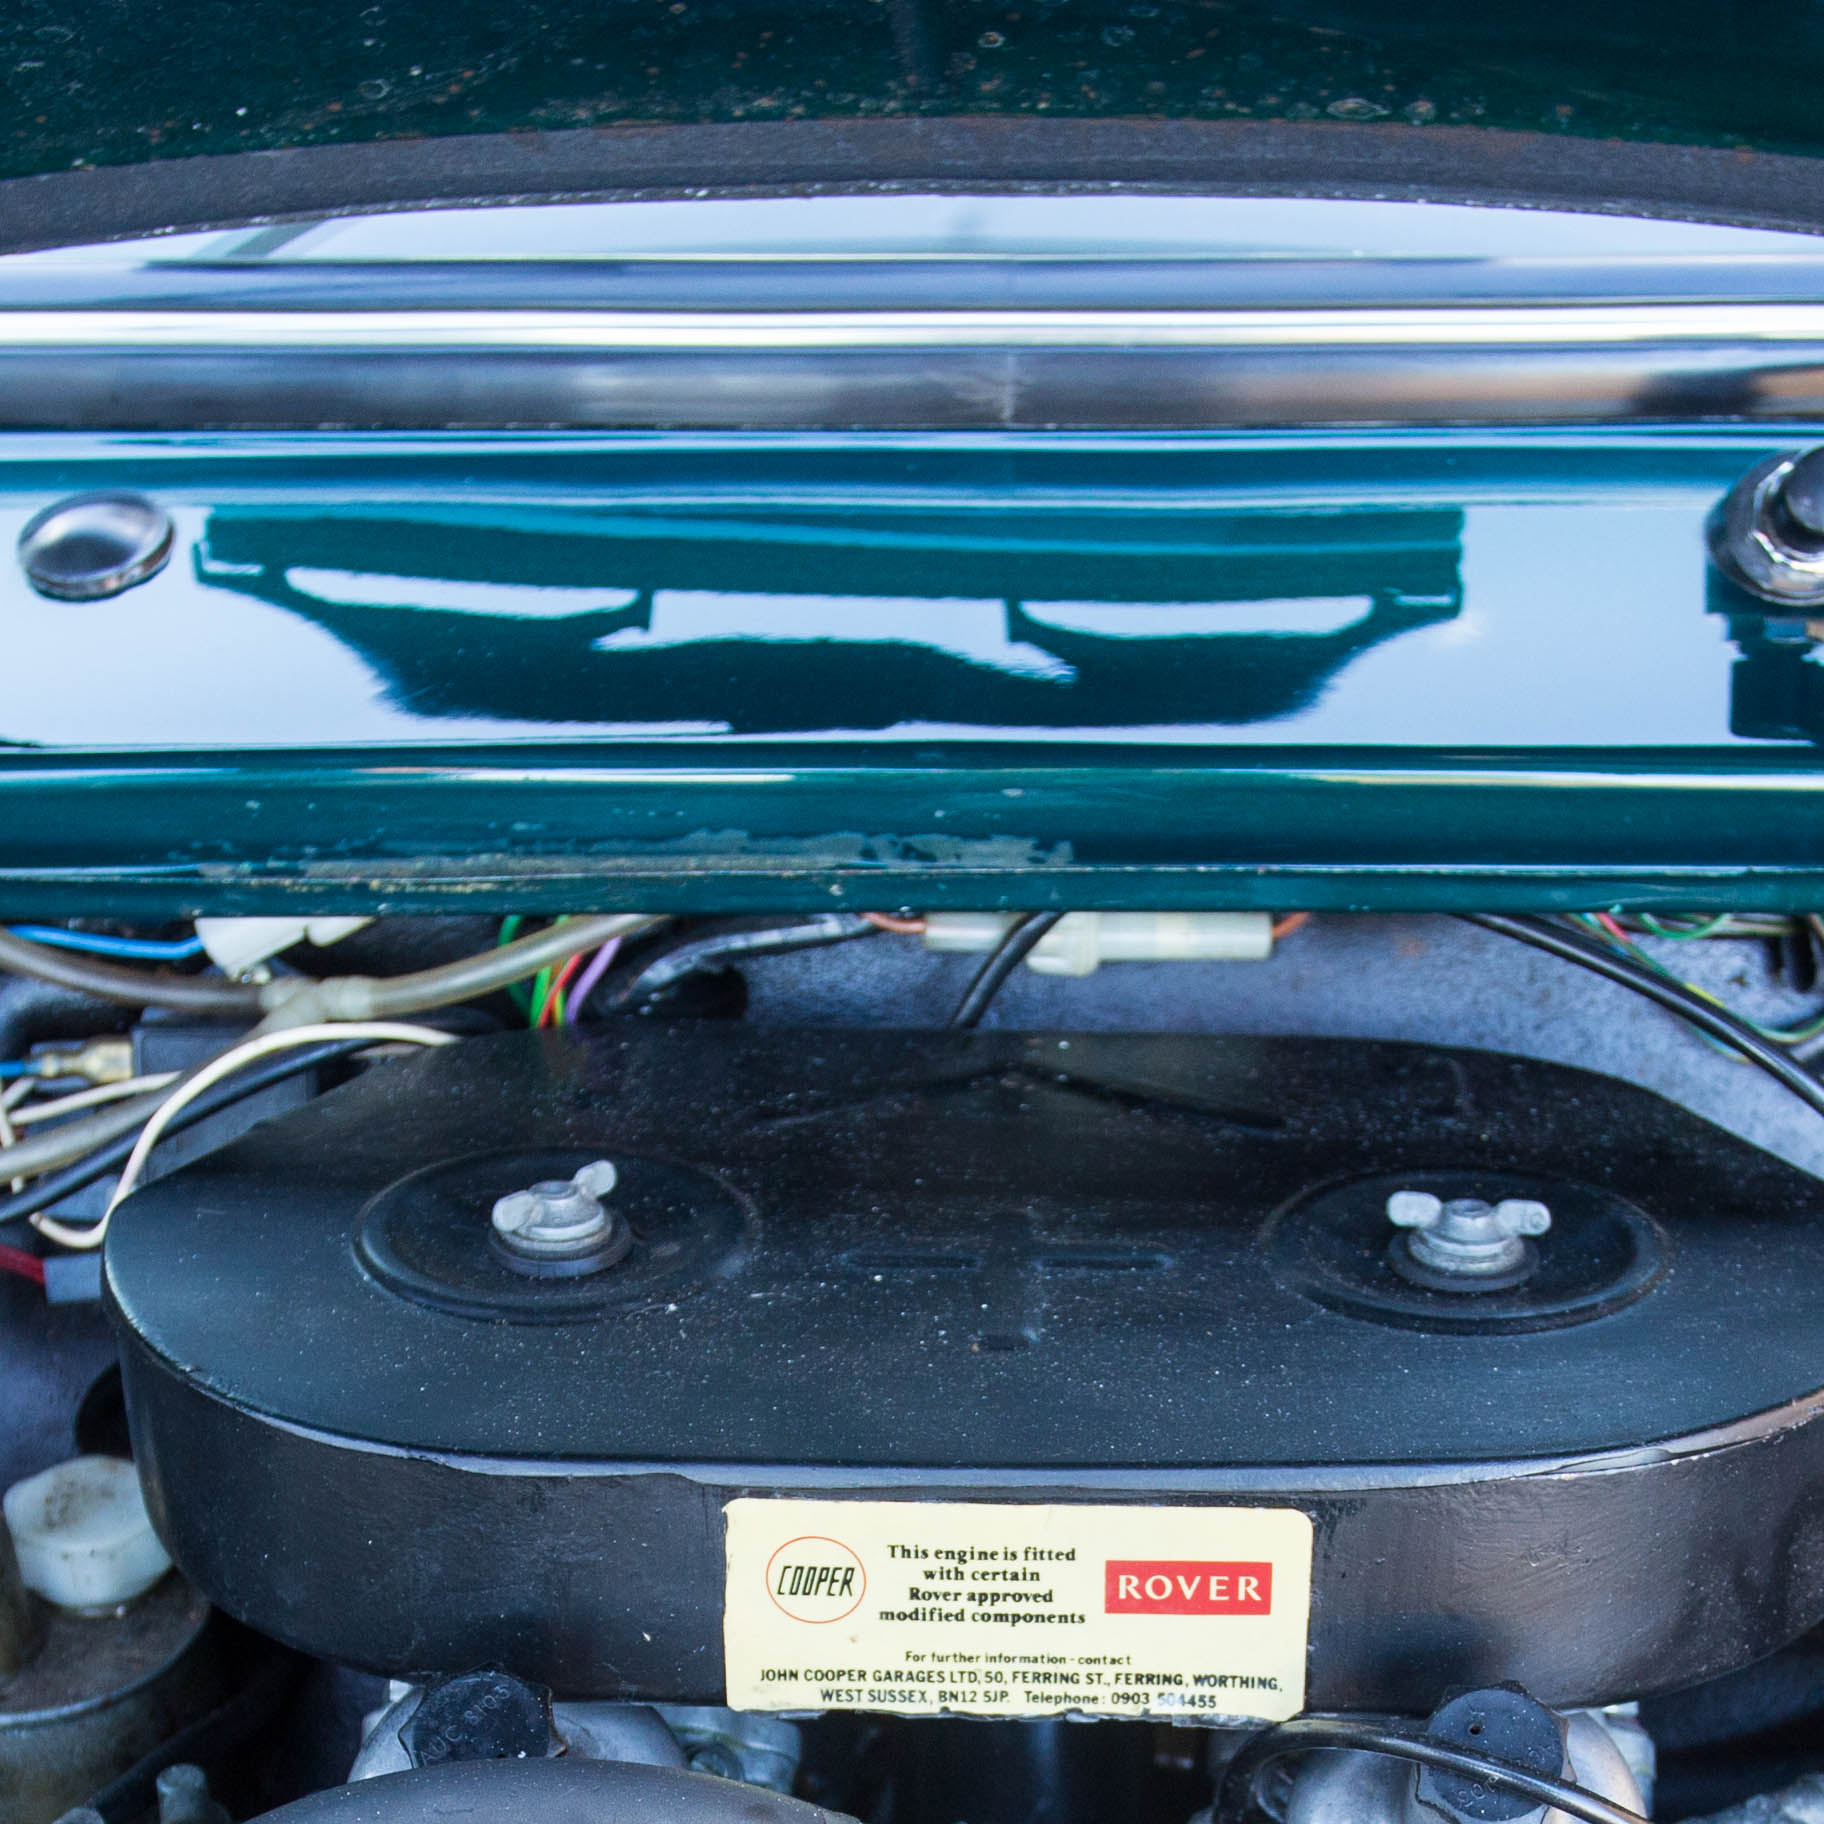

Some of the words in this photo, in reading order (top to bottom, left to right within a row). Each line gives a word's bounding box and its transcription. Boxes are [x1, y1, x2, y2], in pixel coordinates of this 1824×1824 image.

[888, 1545, 928, 1559] This
[934, 1547, 998, 1564] engine
[1003, 1547, 1018, 1561] is
[1024, 1547, 1076, 1561] fitted
[776, 1564, 855, 1598] COOPER
[923, 1567, 964, 1580] with
[971, 1567, 1040, 1581] certain
[909, 1588, 962, 1601] Rover
[967, 1589, 1053, 1606] approved
[1118, 1574, 1262, 1602] ROVER
[879, 1608, 965, 1622] modified
[972, 1612, 1085, 1627] components
[906, 1651, 925, 1661] For
[932, 1652, 980, 1663] further
[985, 1652, 1067, 1665] information
[1078, 1655, 1132, 1666] contact
[761, 1669, 798, 1682] JOHN
[804, 1669, 867, 1682] COOPER
[873, 1670, 945, 1683] GARAGES
[1012, 1672, 1080, 1685] FERRING
[821, 1689, 862, 1702] WEST
[939, 1691, 977, 1703] BN12
[1111, 1693, 1149, 1705] 0903
